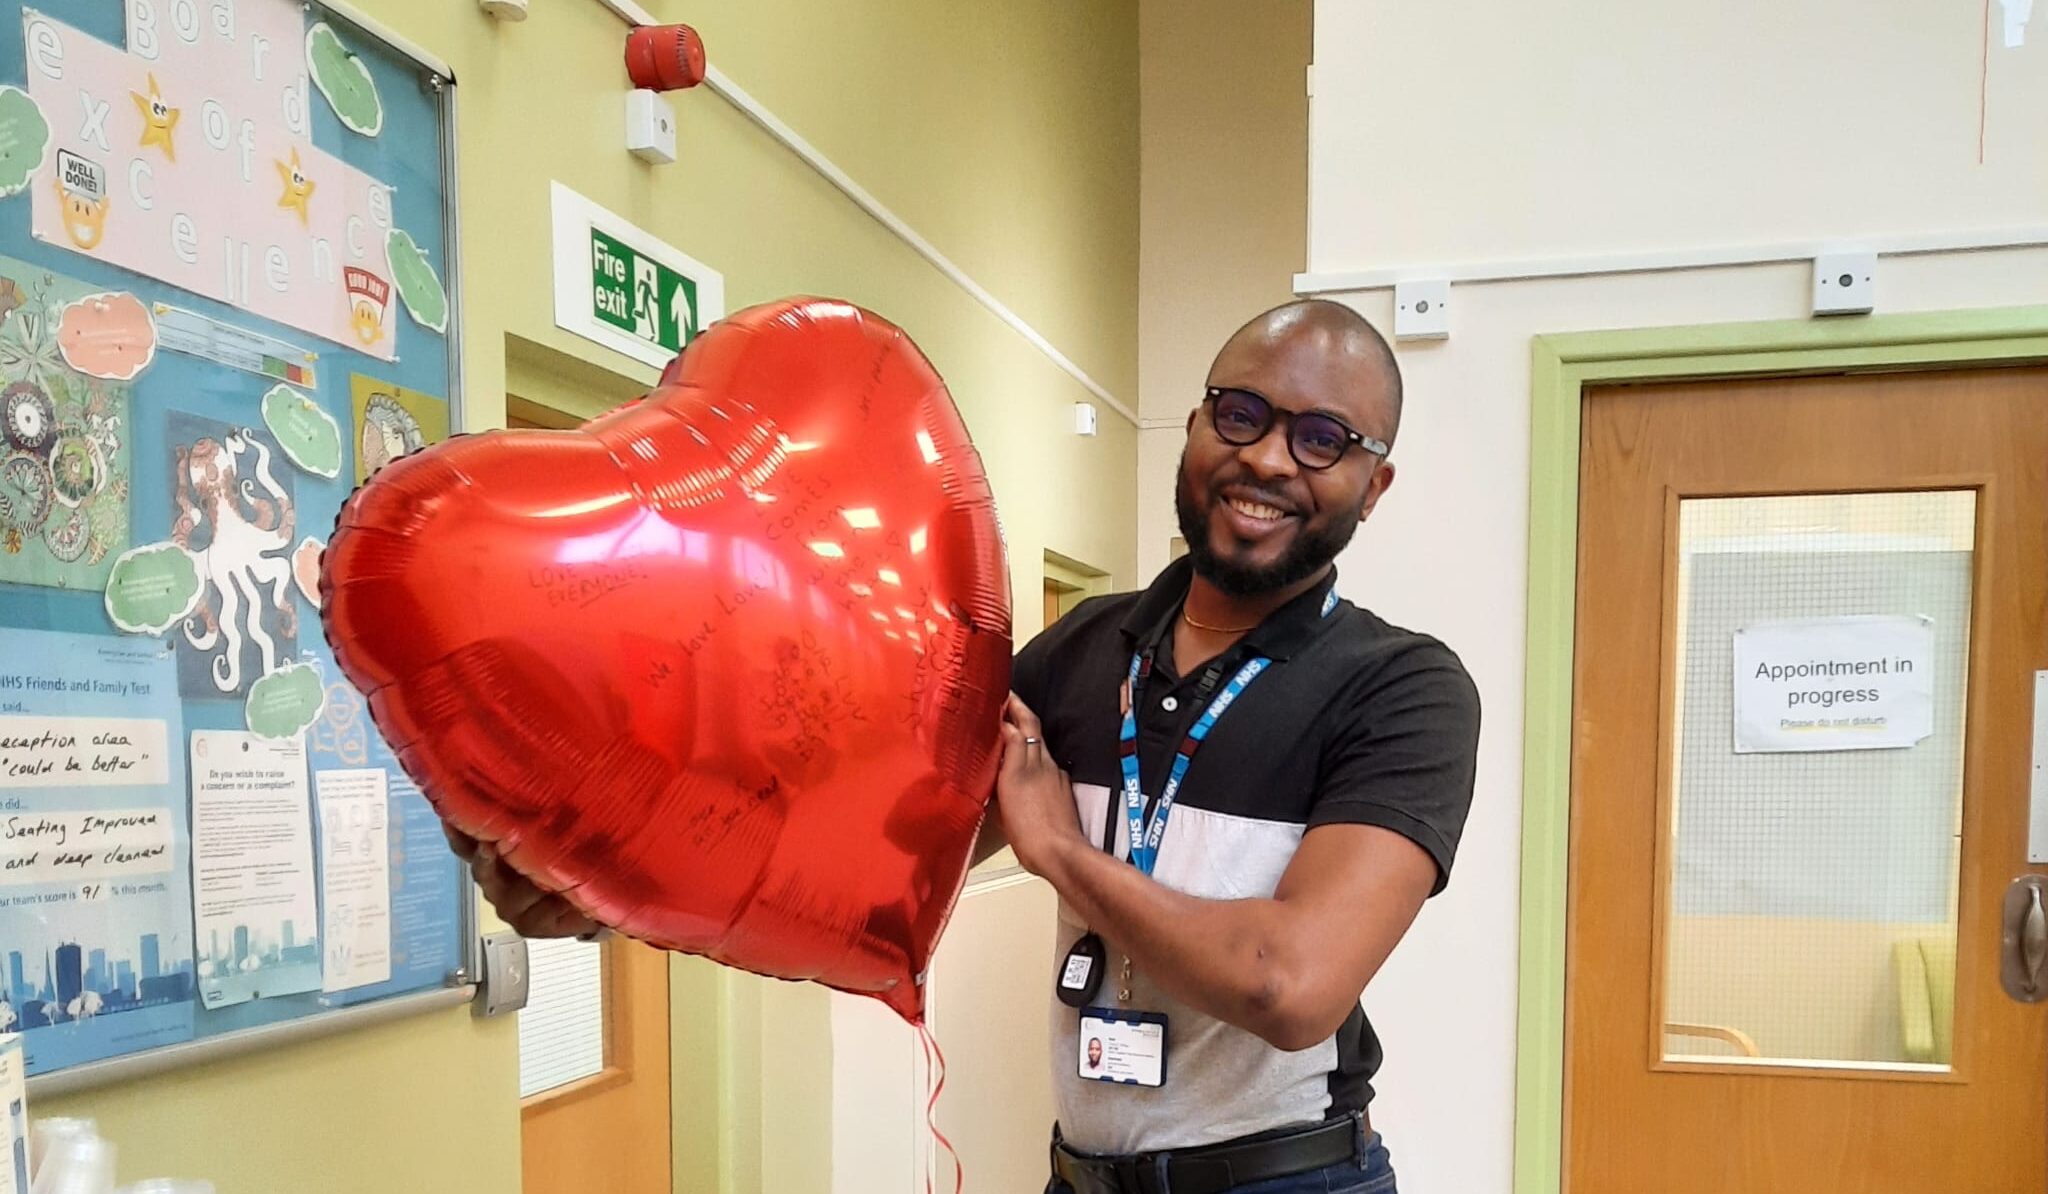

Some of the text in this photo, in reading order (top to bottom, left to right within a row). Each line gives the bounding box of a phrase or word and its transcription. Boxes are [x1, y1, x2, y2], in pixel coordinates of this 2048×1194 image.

[201, 99, 256, 182] of
[66, 157, 95, 180] WELL
[593, 239, 626, 283] Fire
[595, 285, 628, 320] exit
[1236, 660, 1261, 686] NHS
[1755, 656, 1914, 682] Appointment in
[26, 676, 67, 692] Friends
[70, 679, 90, 692] and
[93, 680, 128, 696] Family
[131, 682, 150, 695] Test
[1788, 688, 1880, 709] progress
[1208, 689, 1234, 718] NHS
[92, 732, 132, 747] area
[65, 756, 82, 771] be
[1126, 778, 1140, 808] NHS
[1162, 777, 1178, 811] NHS
[6, 814, 157, 846] Seating Improved
[1129, 818, 1143, 849] NHS
[1148, 817, 1165, 850] NHS
[5, 851, 39, 870] and
